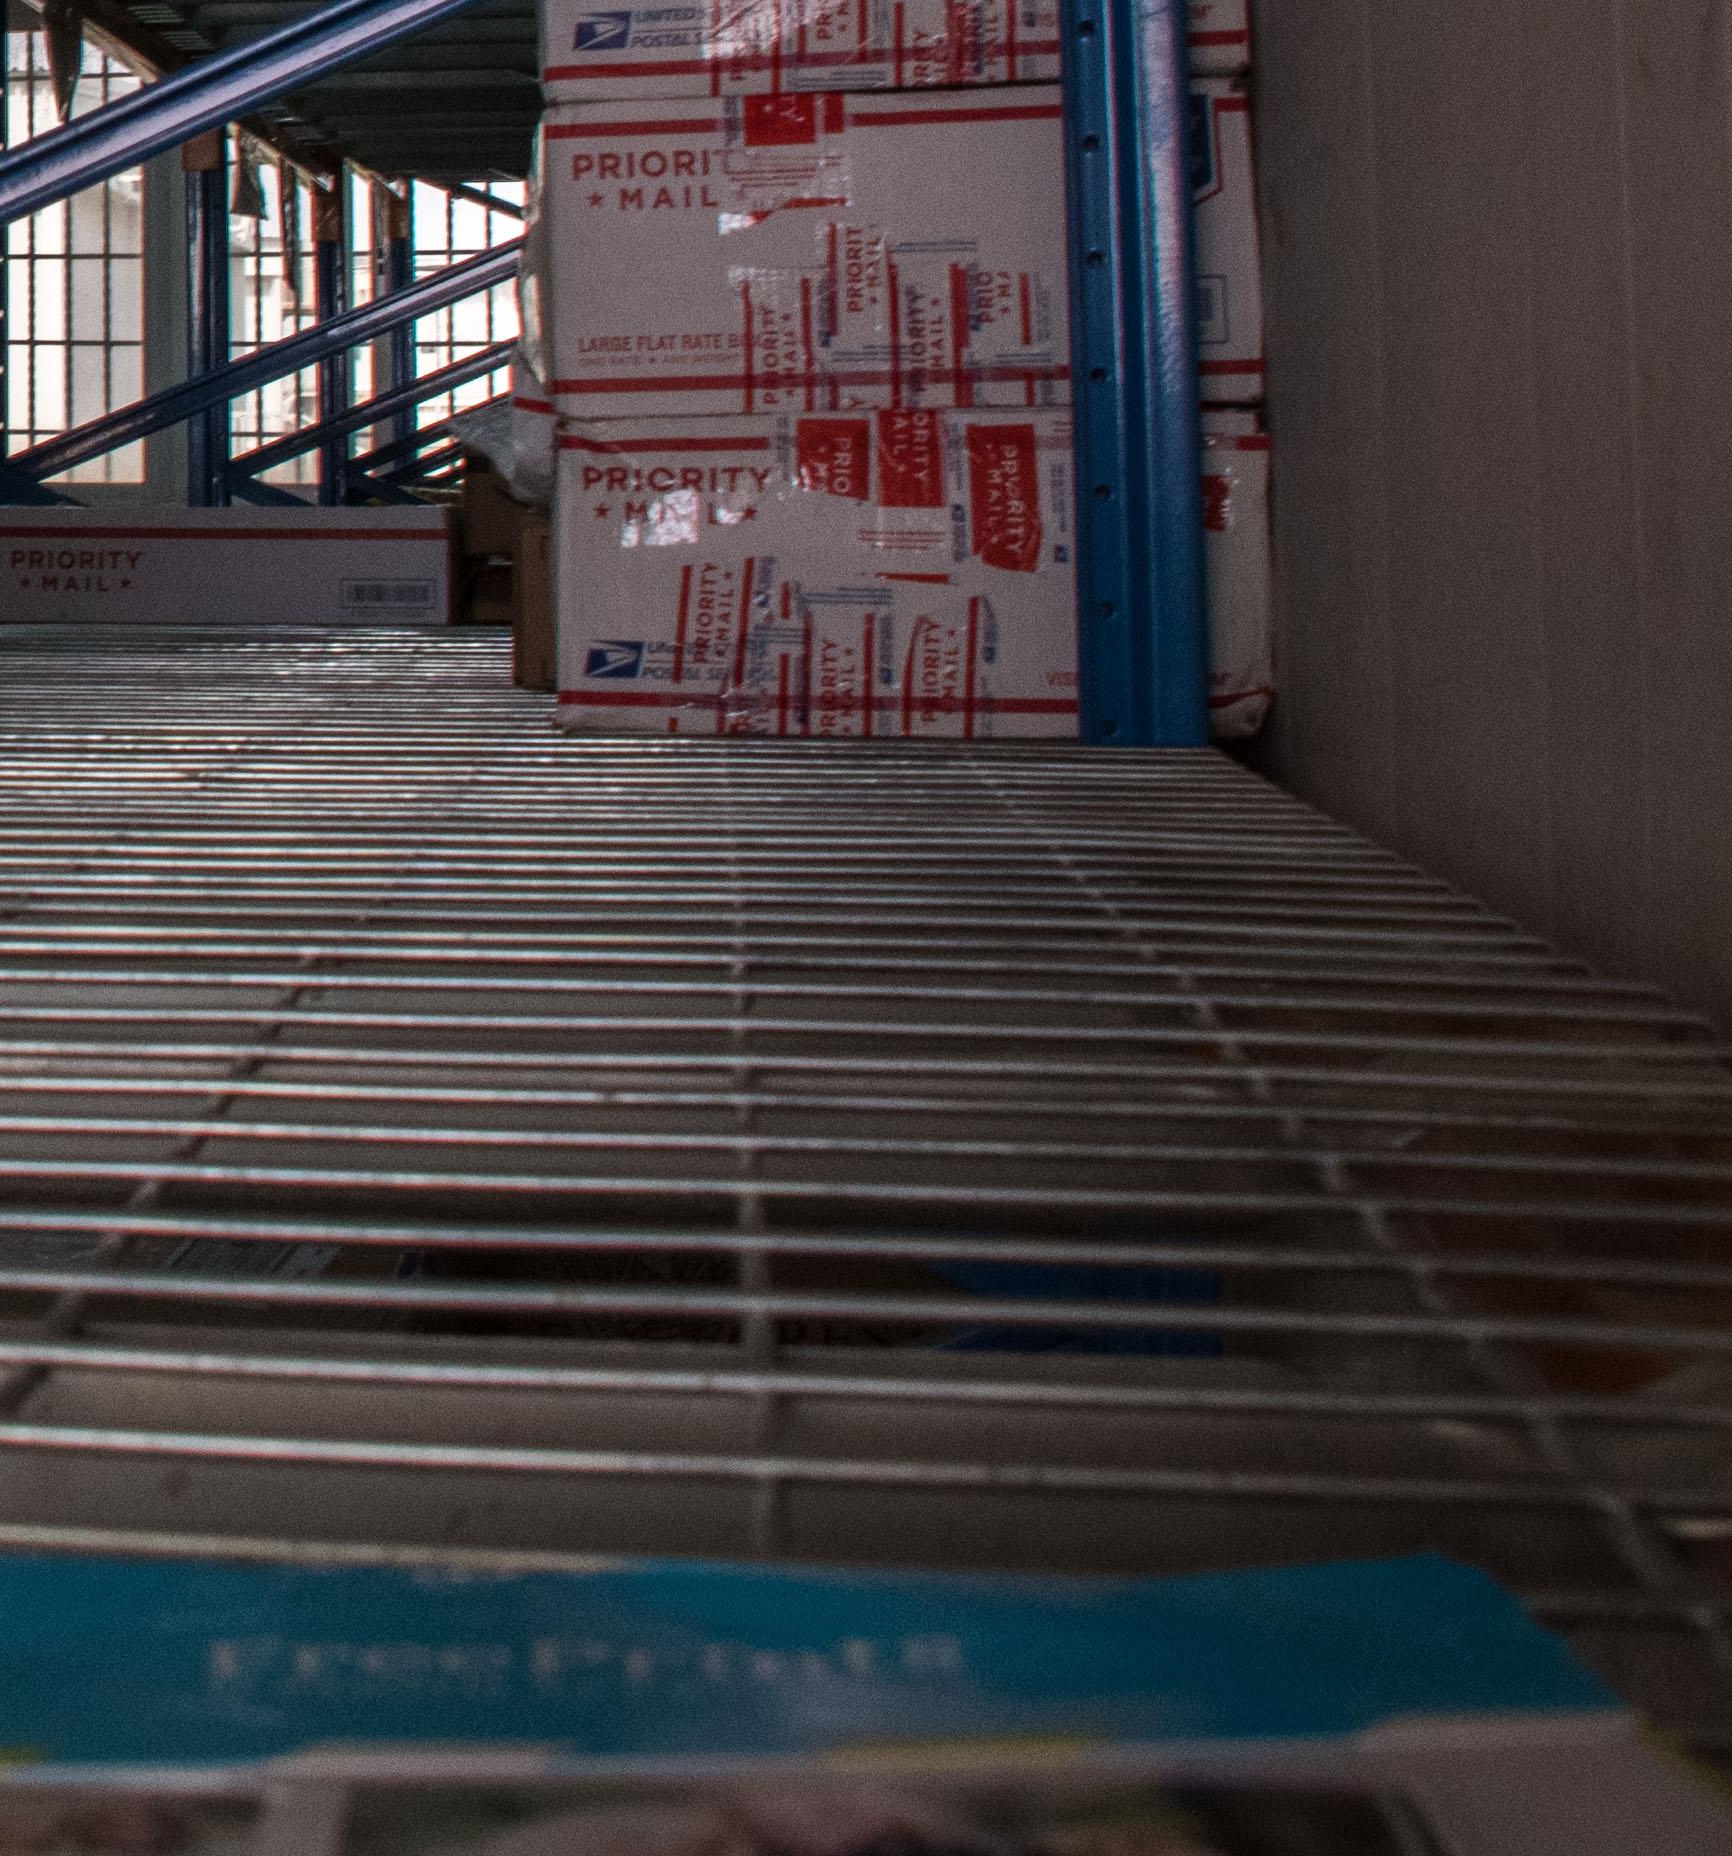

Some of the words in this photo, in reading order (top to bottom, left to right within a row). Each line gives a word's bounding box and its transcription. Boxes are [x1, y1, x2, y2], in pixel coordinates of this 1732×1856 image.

[619, 184, 719, 211] MAIL
[584, 466, 772, 494] PRIORITY
[11, 549, 142, 570] PRIORITY
[41, 576, 108, 592] MAIL
[693, 562, 718, 664] PRIORITY
[717, 589, 735, 642] MAIL
